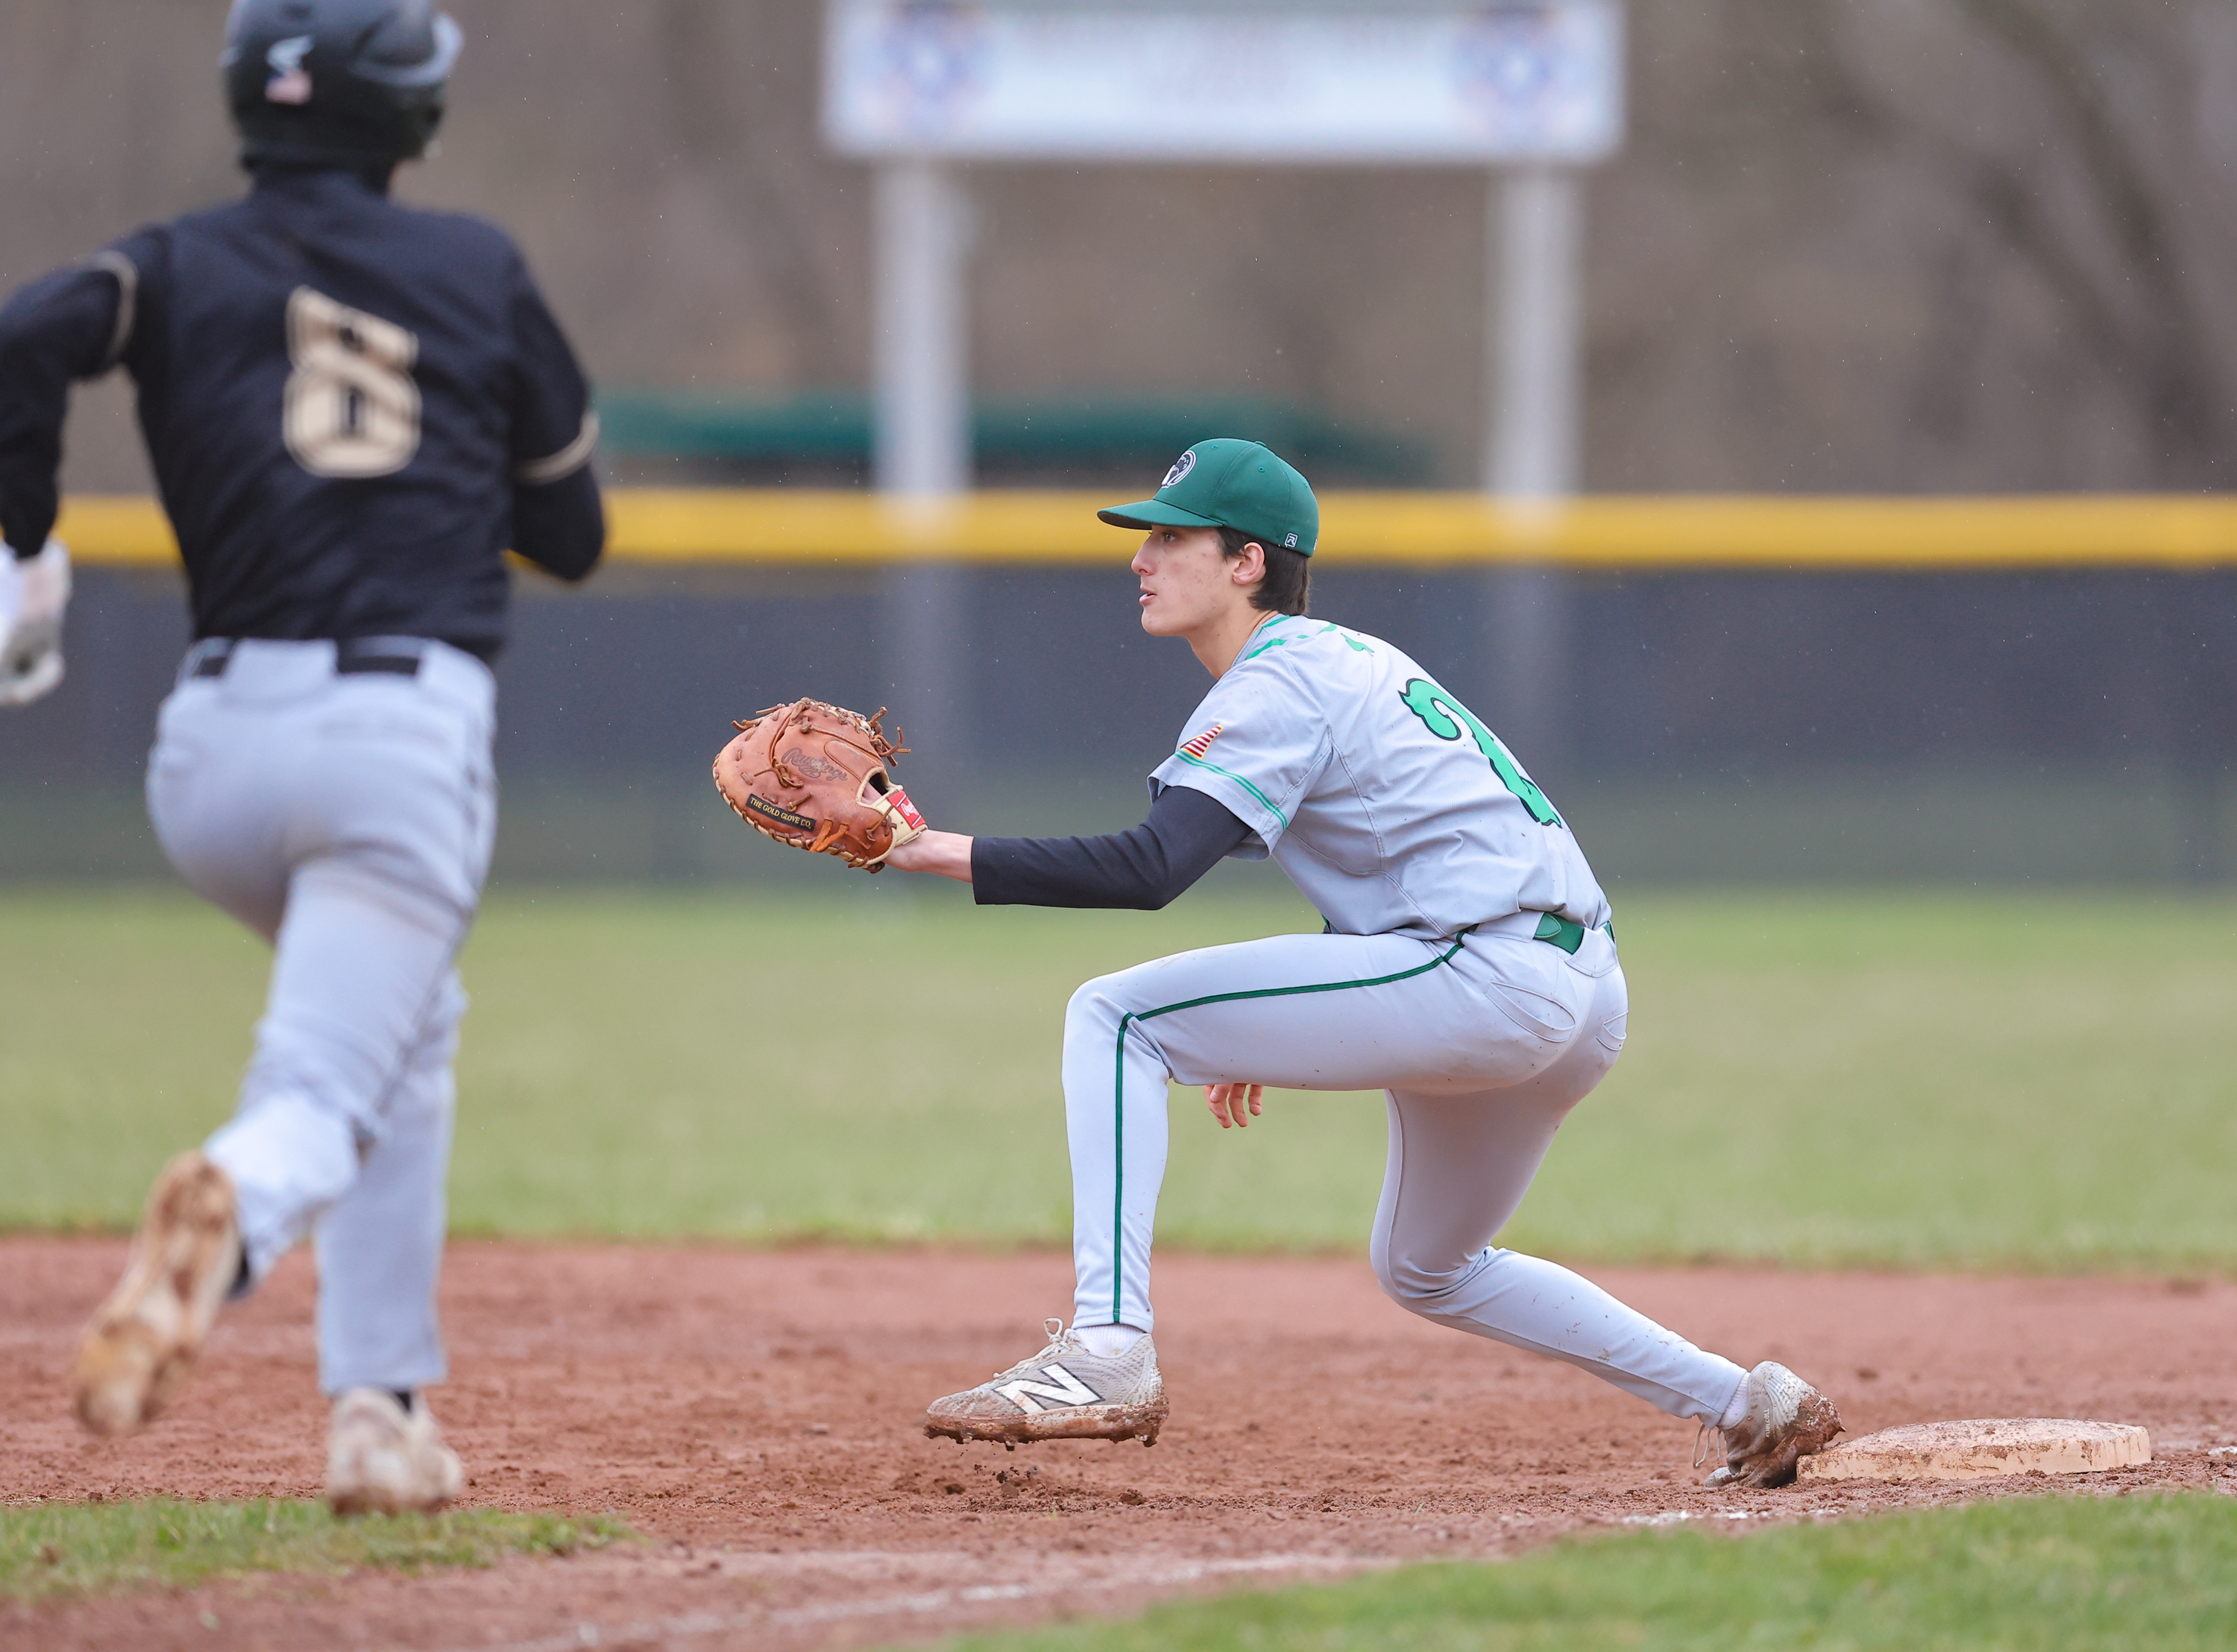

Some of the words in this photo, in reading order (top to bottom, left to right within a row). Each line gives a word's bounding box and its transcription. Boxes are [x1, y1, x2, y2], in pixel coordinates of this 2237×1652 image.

[750, 797, 763, 809] THE
[763, 804, 780, 816] GOLD
[781, 812, 800, 824] GLOVE
[992, 1362, 1106, 1413] N
